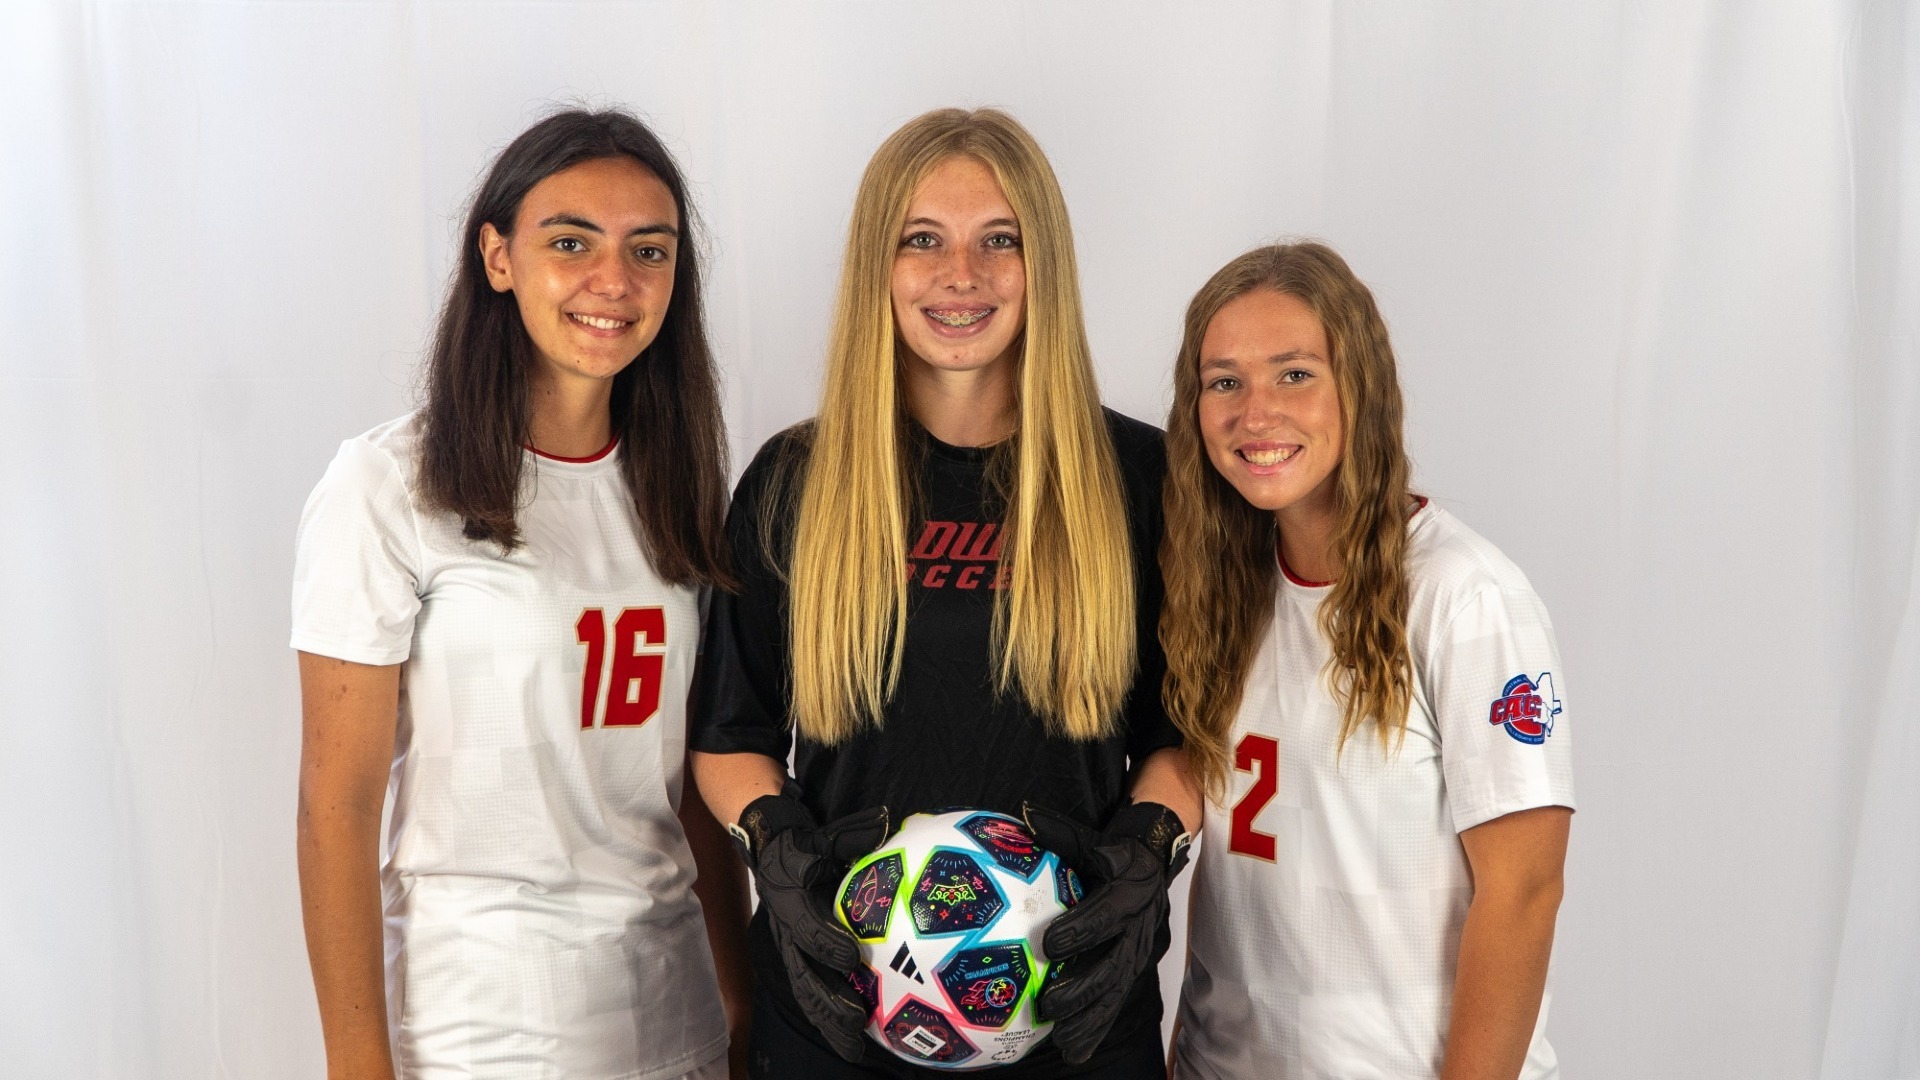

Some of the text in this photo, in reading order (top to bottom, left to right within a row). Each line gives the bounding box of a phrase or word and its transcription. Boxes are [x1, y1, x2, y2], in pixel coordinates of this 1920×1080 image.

[907, 520, 1012, 561] DW
[574, 605, 667, 731] 16
[1227, 731, 1280, 864] 2
[964, 963, 1010, 980] CHAMPIONS
[994, 1032, 1036, 1042] CHAMPIONS
[1005, 1029, 1031, 1037] LEAGUE
